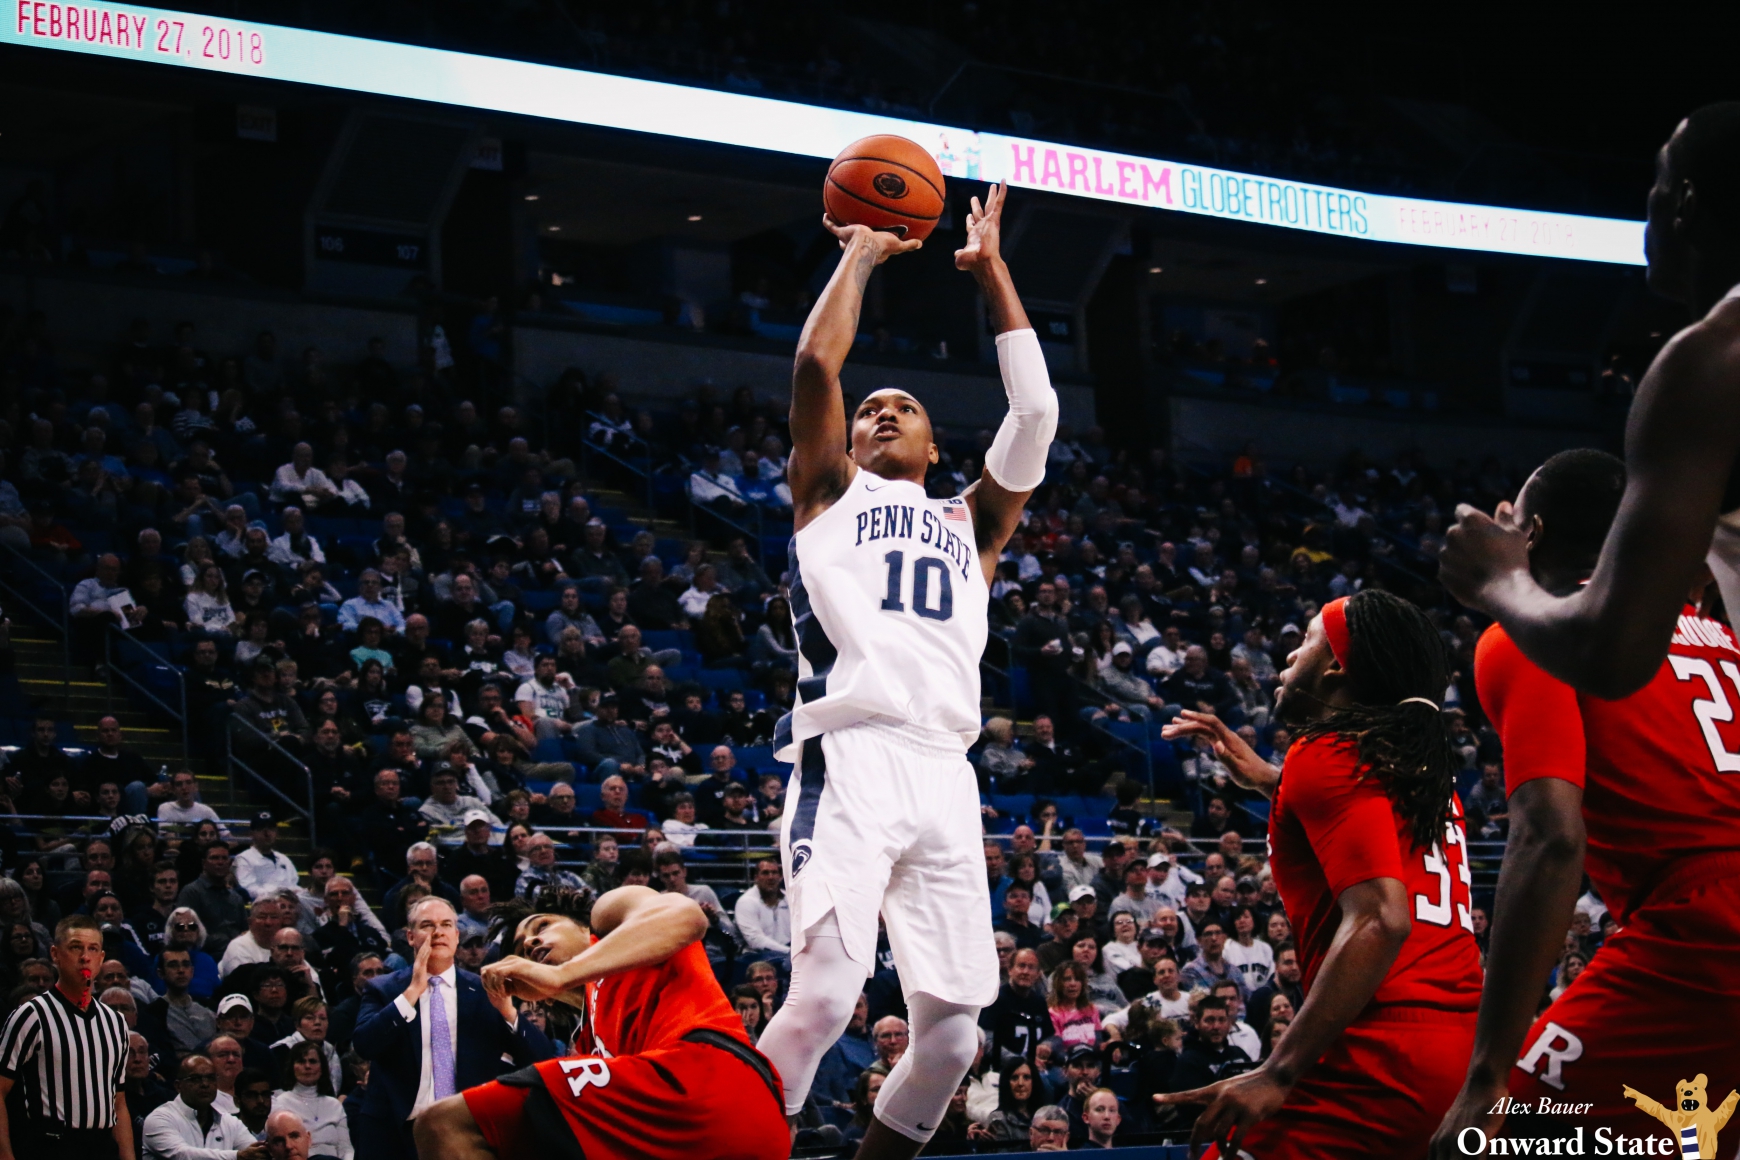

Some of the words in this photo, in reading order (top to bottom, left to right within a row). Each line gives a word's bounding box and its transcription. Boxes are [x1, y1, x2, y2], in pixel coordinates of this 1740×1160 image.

[18, 0, 147, 48] FEBRUARY
[157, 20, 191, 58] 27,
[202, 26, 262, 64] 2018
[1011, 144, 1173, 204] HARLEM
[1181, 168, 1368, 234] GLOBETROTTERS
[1400, 207, 1490, 238] FEBRUARY
[855, 505, 915, 547] PENN
[921, 509, 971, 583] STATE
[880, 549, 954, 622] 10
[1416, 821, 1474, 934] 33
[558, 1058, 611, 1098] R
[1516, 1021, 1584, 1091] R
